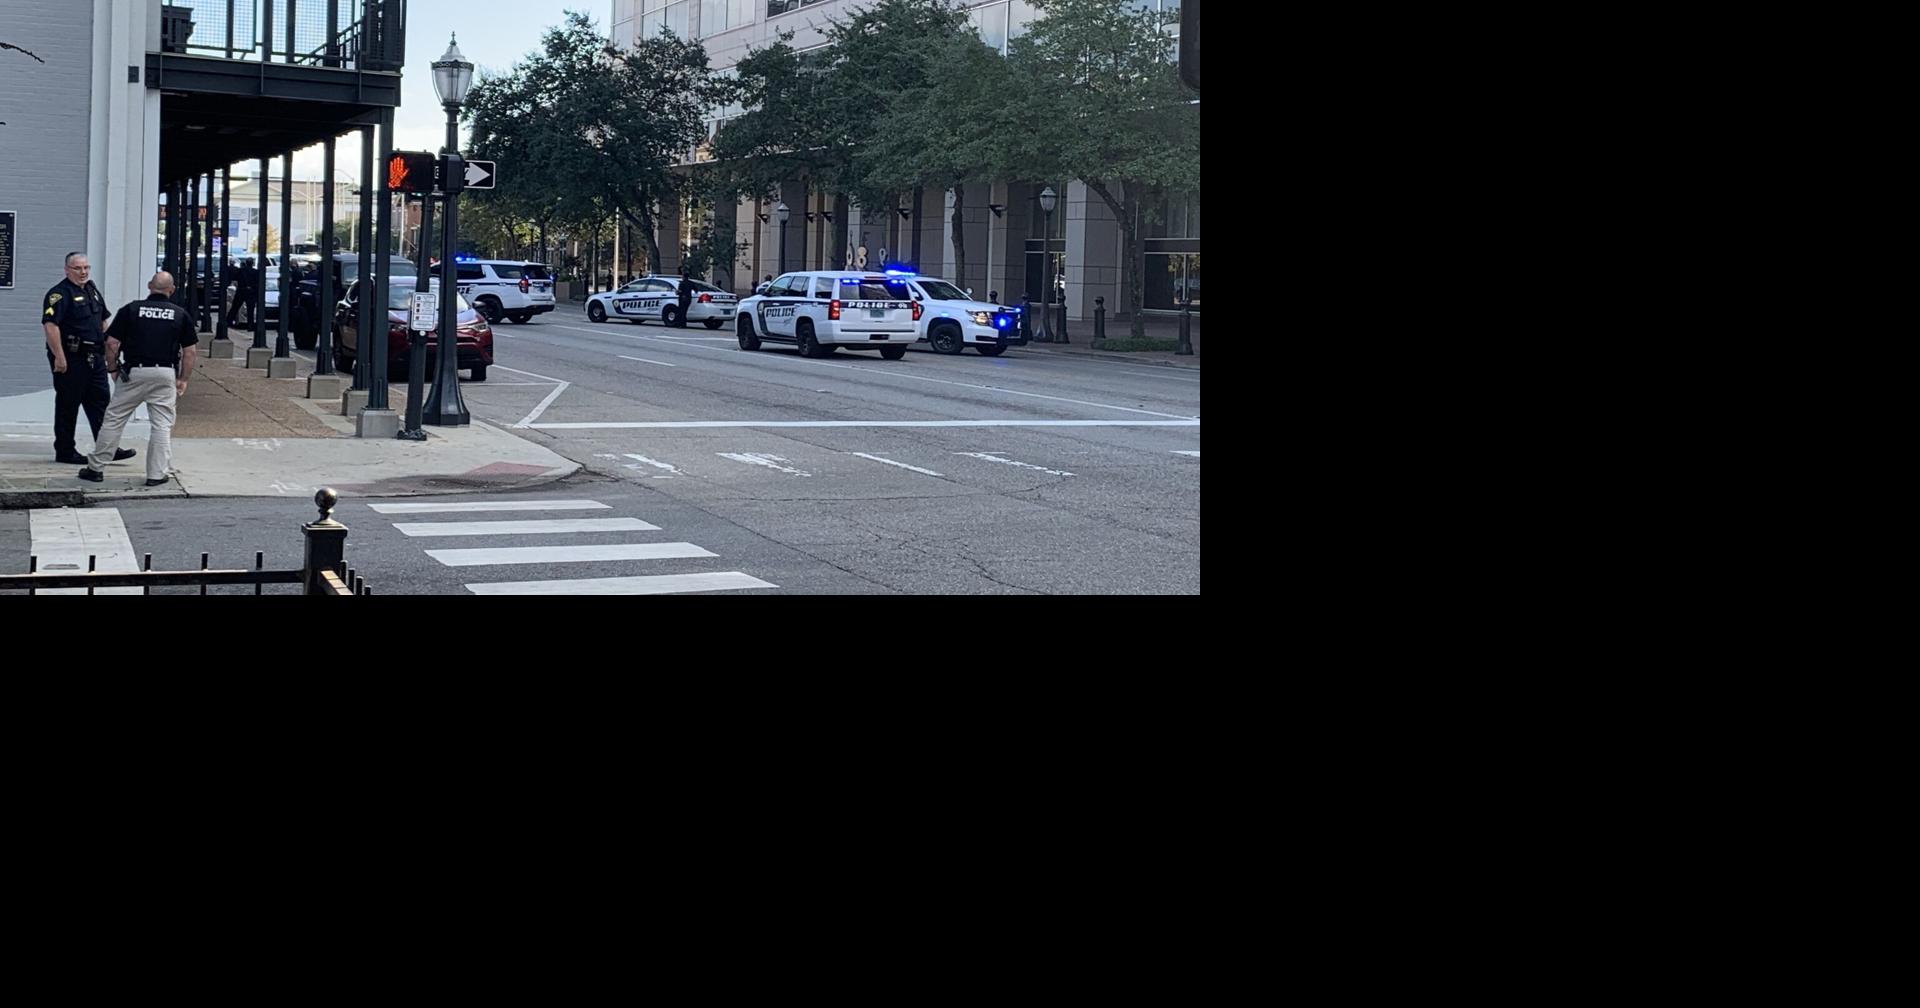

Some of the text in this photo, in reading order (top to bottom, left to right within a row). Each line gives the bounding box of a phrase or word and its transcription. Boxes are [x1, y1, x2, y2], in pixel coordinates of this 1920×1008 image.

[622, 300, 660, 309] POLICE
[139, 310, 175, 320] POLICE
[766, 307, 795, 317] POLICE
